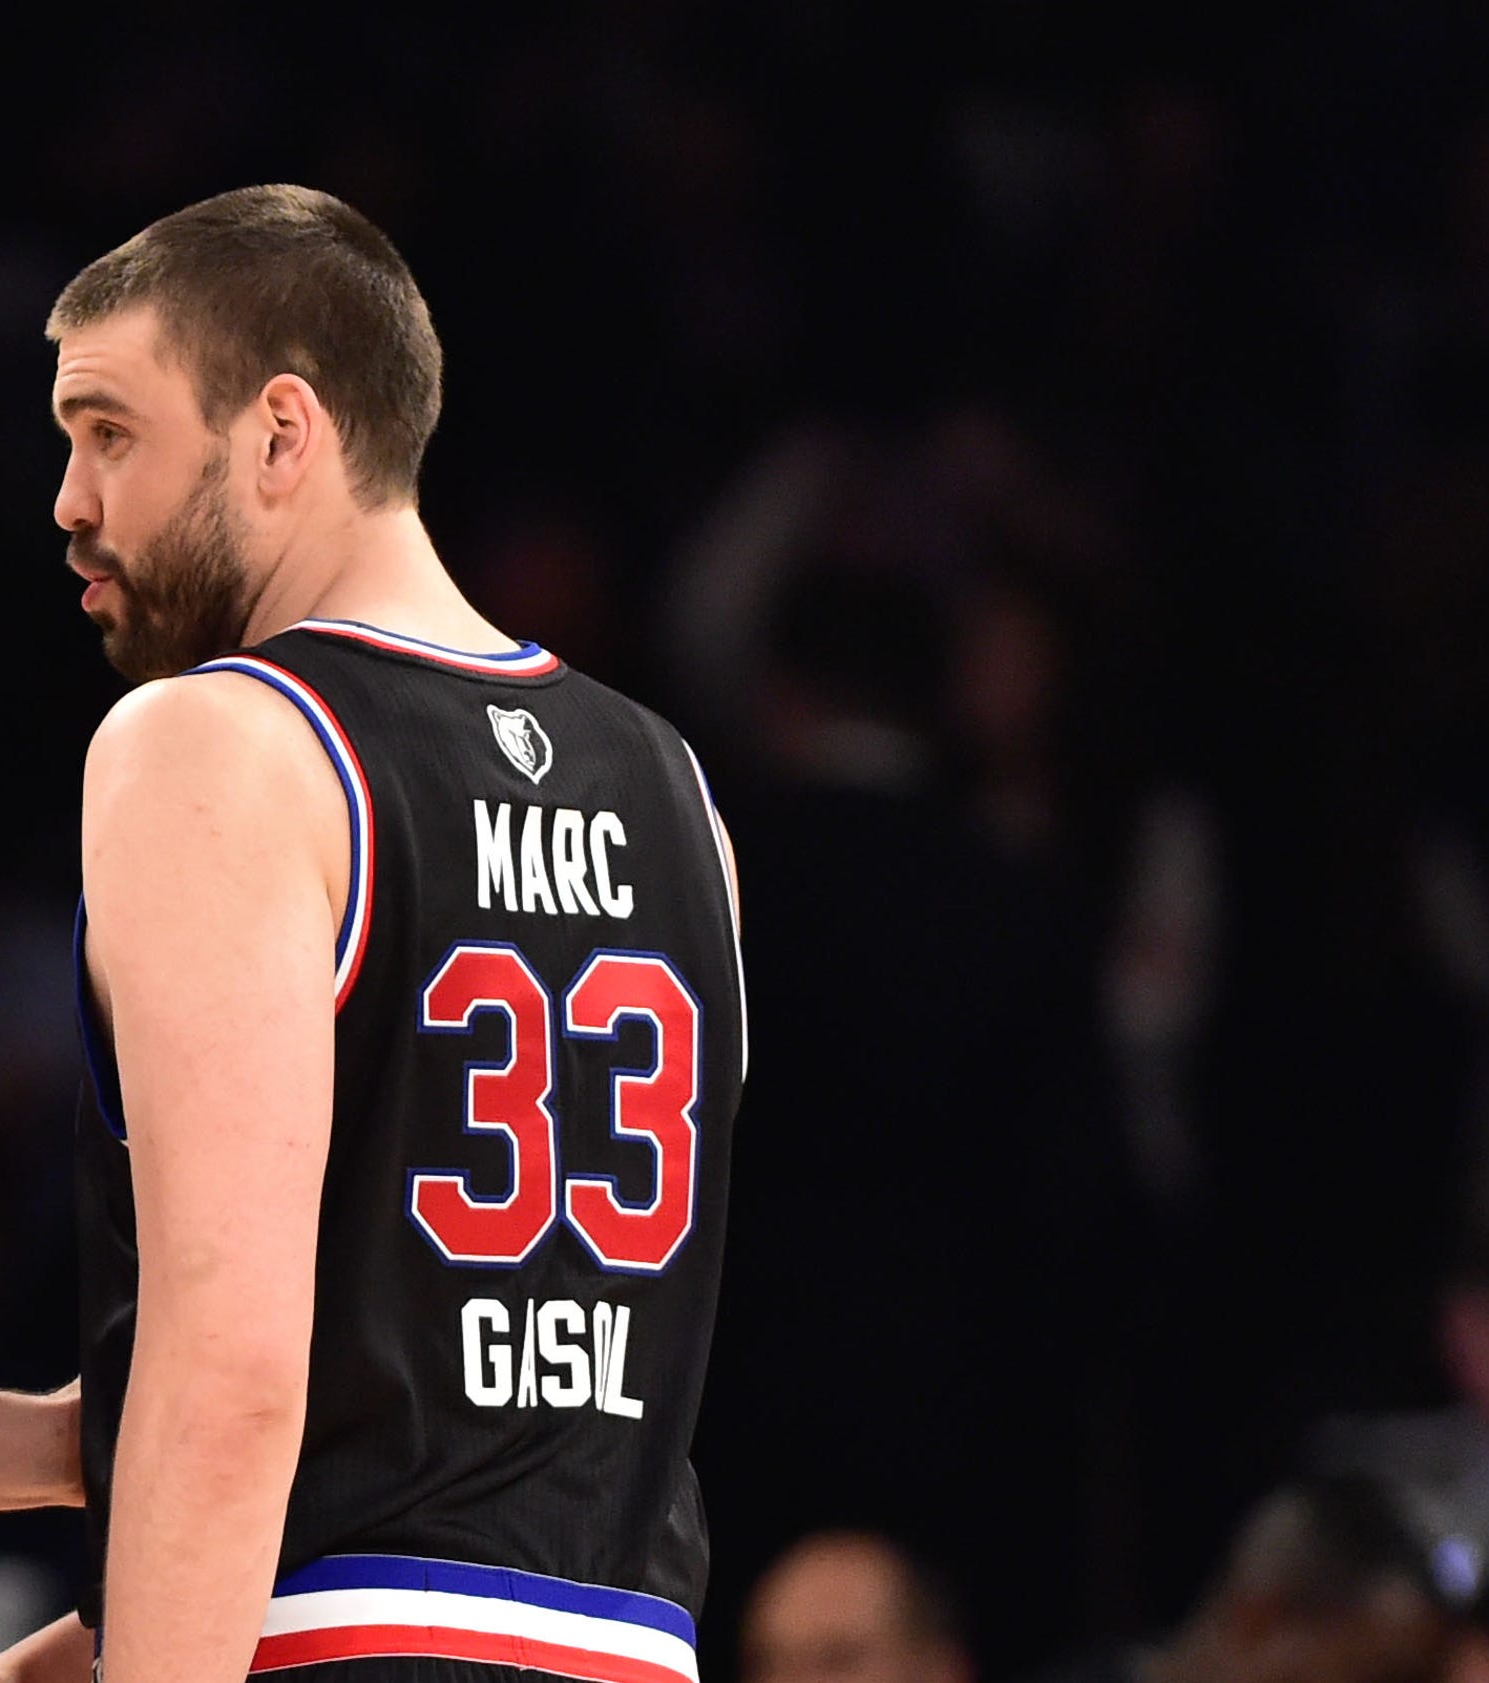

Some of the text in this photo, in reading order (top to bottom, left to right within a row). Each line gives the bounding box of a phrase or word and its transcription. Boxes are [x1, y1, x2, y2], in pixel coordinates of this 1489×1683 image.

[473, 799, 634, 919] MARC
[407, 939, 703, 1276] 33
[461, 1298, 643, 1420] GASOL
